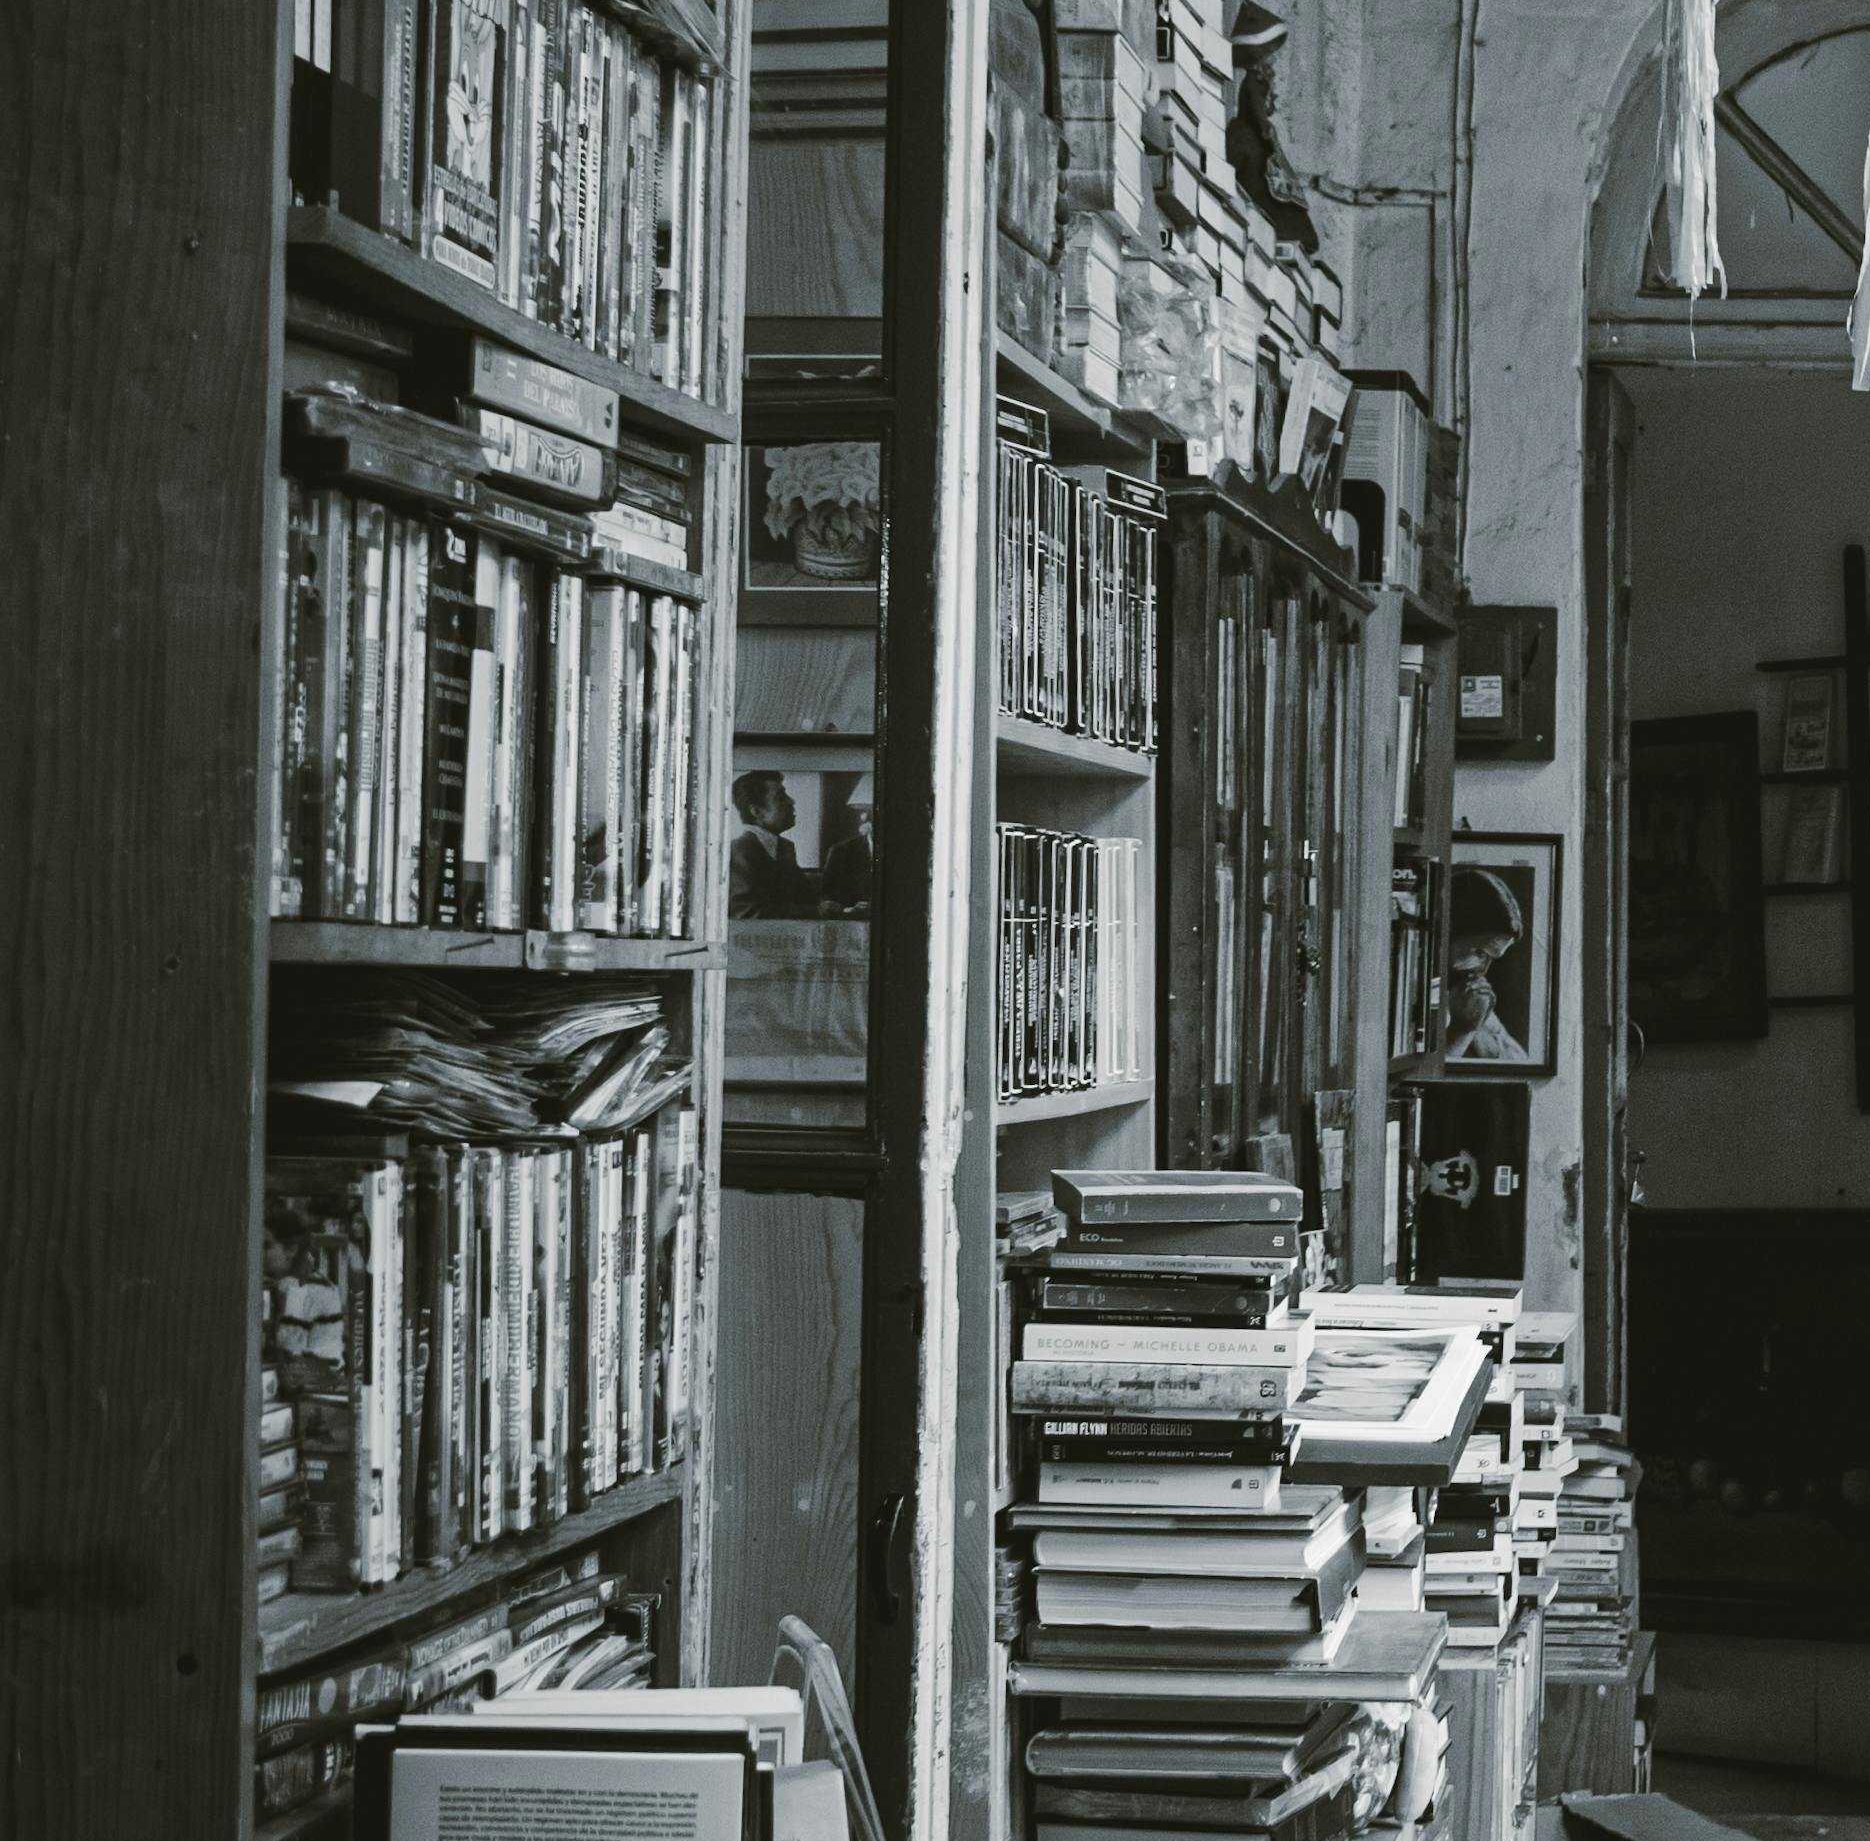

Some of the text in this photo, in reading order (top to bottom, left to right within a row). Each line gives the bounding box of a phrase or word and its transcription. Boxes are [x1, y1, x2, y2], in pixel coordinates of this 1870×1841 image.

[1080, 1233, 1100, 1243] ECO
[681, 1315, 690, 1397] trece
[1038, 1338, 1258, 1354] BECOMING MICHELLE OBAMA
[1044, 1421, 1193, 1437] GILLIAN FLYNN HERIDAS ABIERTAS
[415, 1639, 443, 1666] VOYAGE
[259, 1680, 310, 1734] FANTASIA
